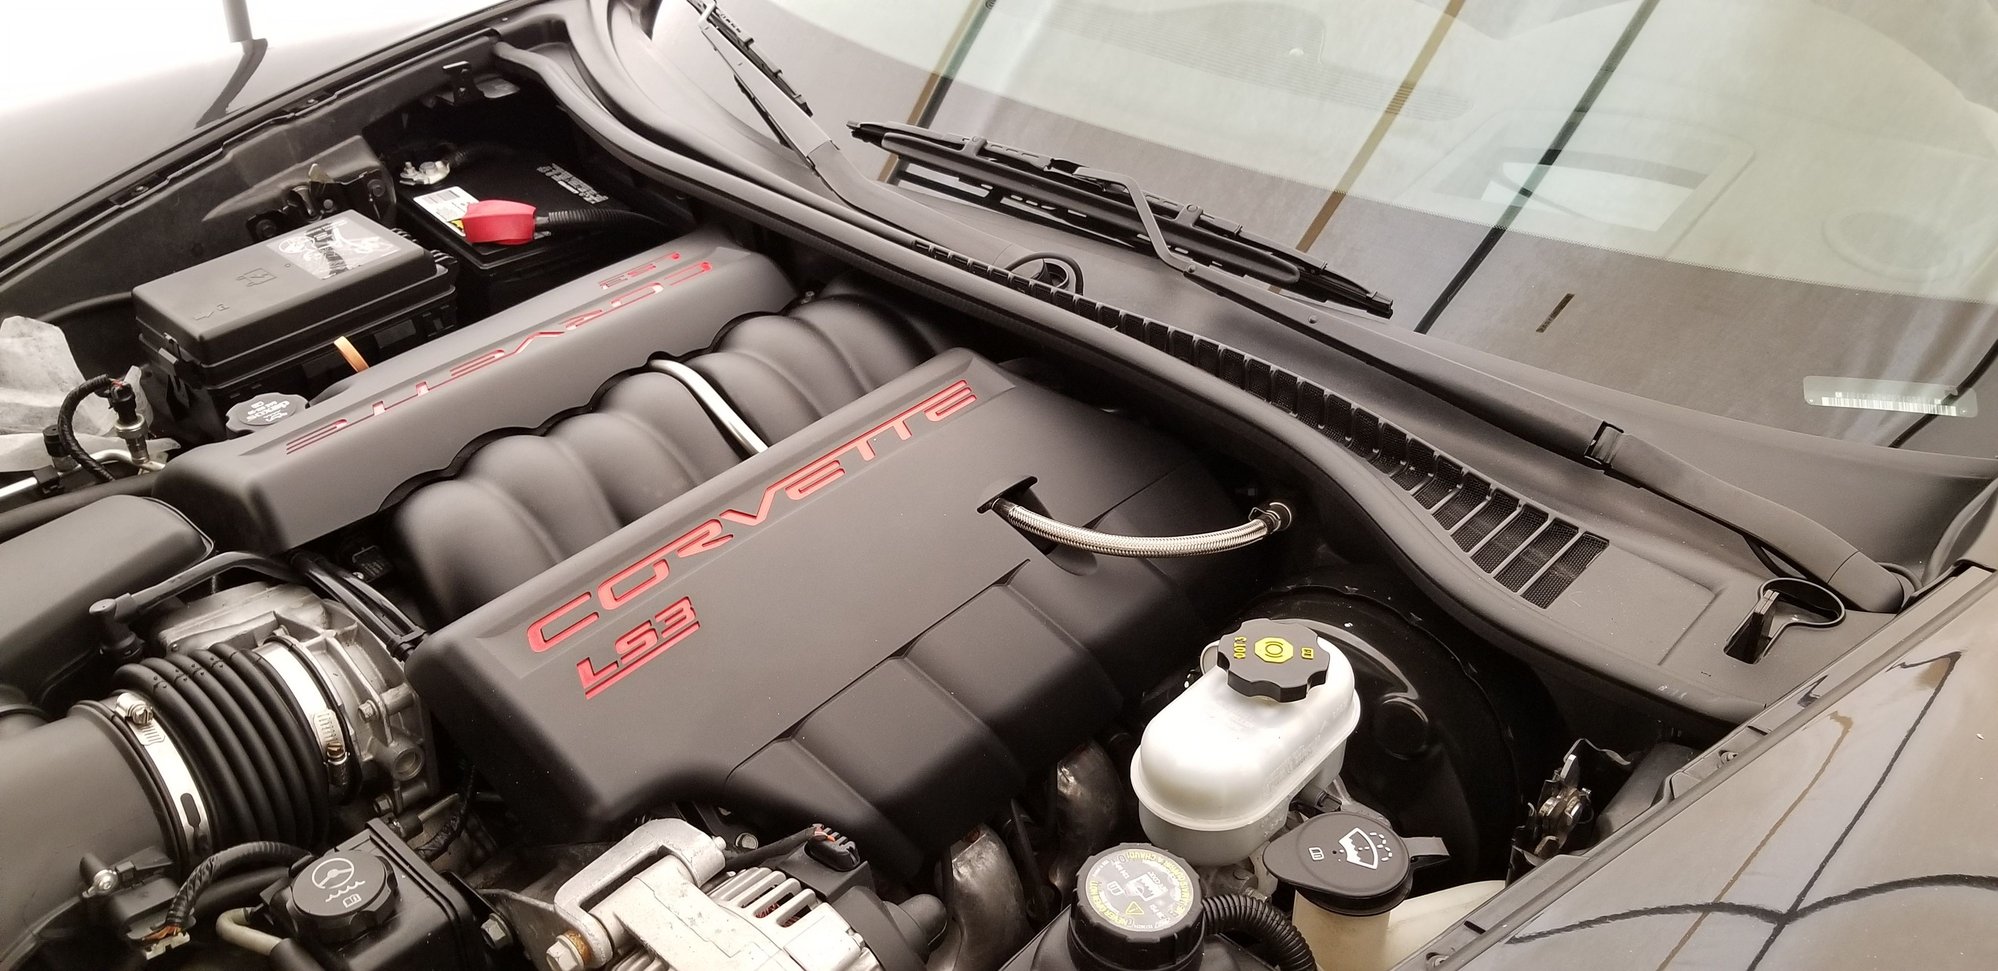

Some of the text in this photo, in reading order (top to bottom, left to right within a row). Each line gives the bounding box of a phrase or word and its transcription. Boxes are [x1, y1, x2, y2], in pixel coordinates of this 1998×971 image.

[285, 261, 712, 456] CORVETTE
[526, 379, 978, 653] CORVETTE
[577, 596, 701, 698] LS3
